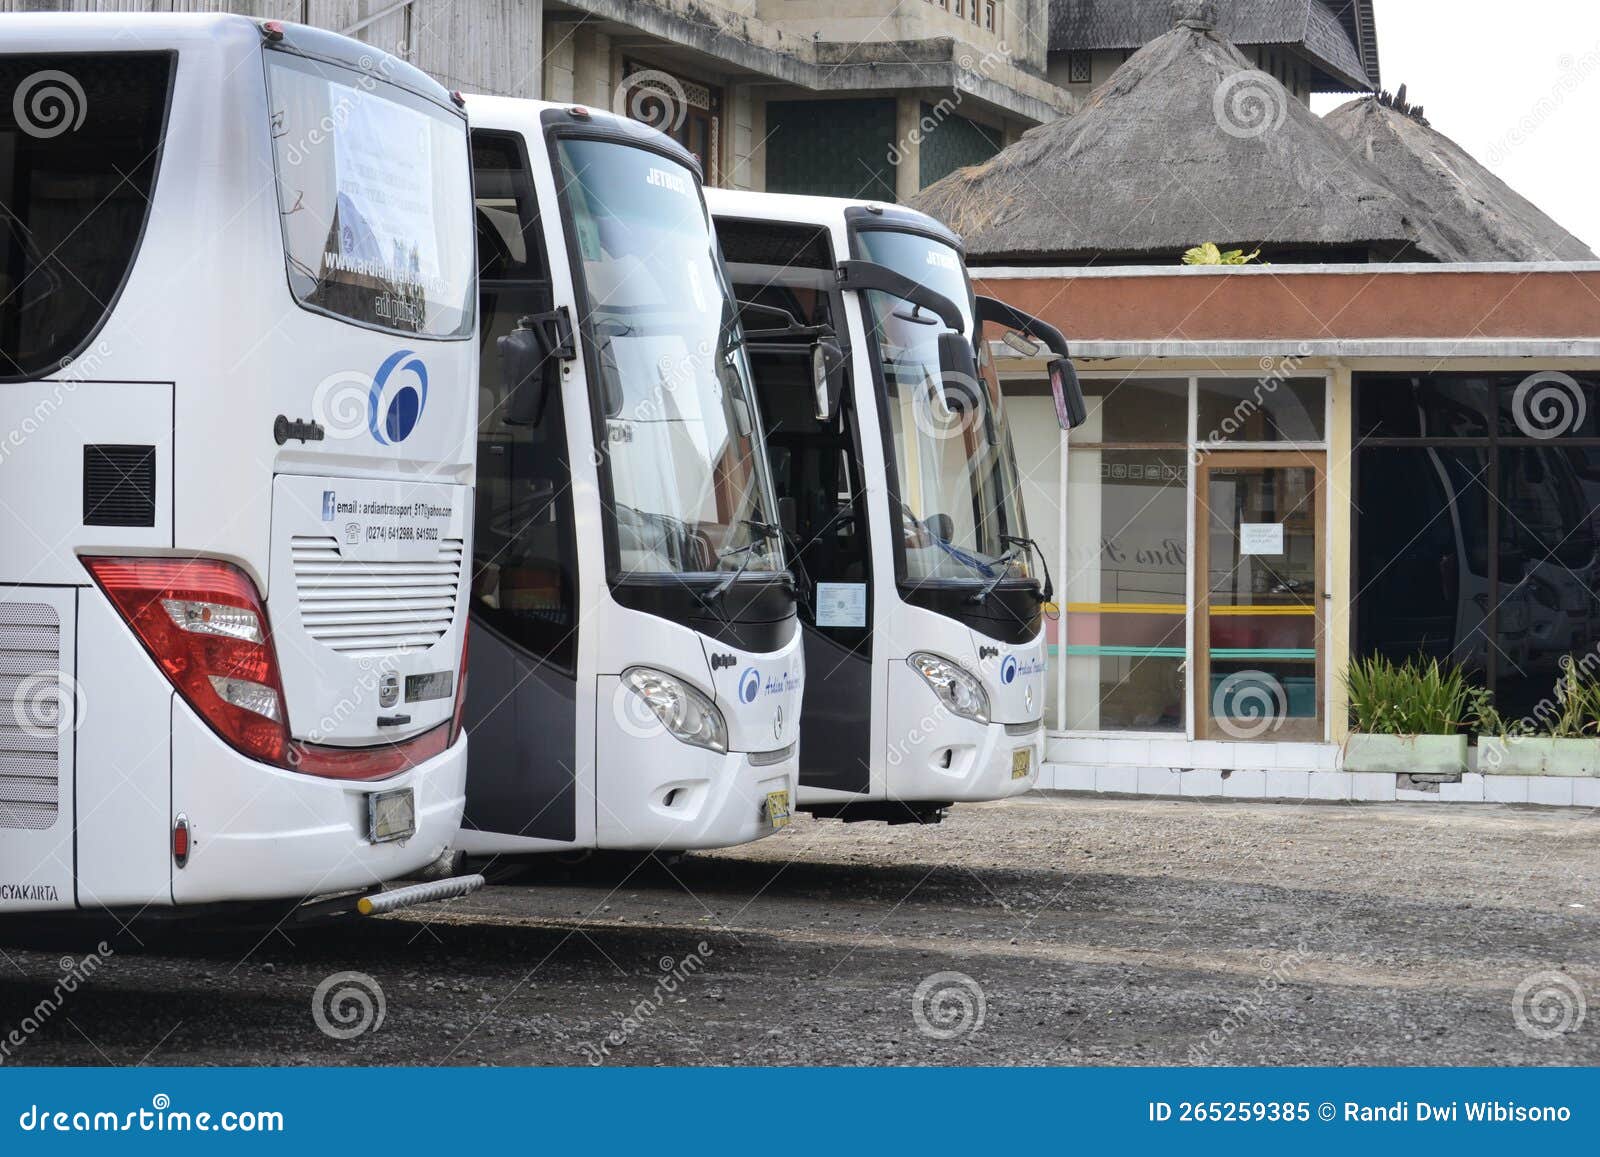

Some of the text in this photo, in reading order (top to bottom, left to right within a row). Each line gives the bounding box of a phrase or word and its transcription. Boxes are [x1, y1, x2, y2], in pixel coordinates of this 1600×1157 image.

[337, 501, 357, 514] email
[366, 526, 387, 542] (0274)
[0, 885, 58, 901] GYAKARTA
